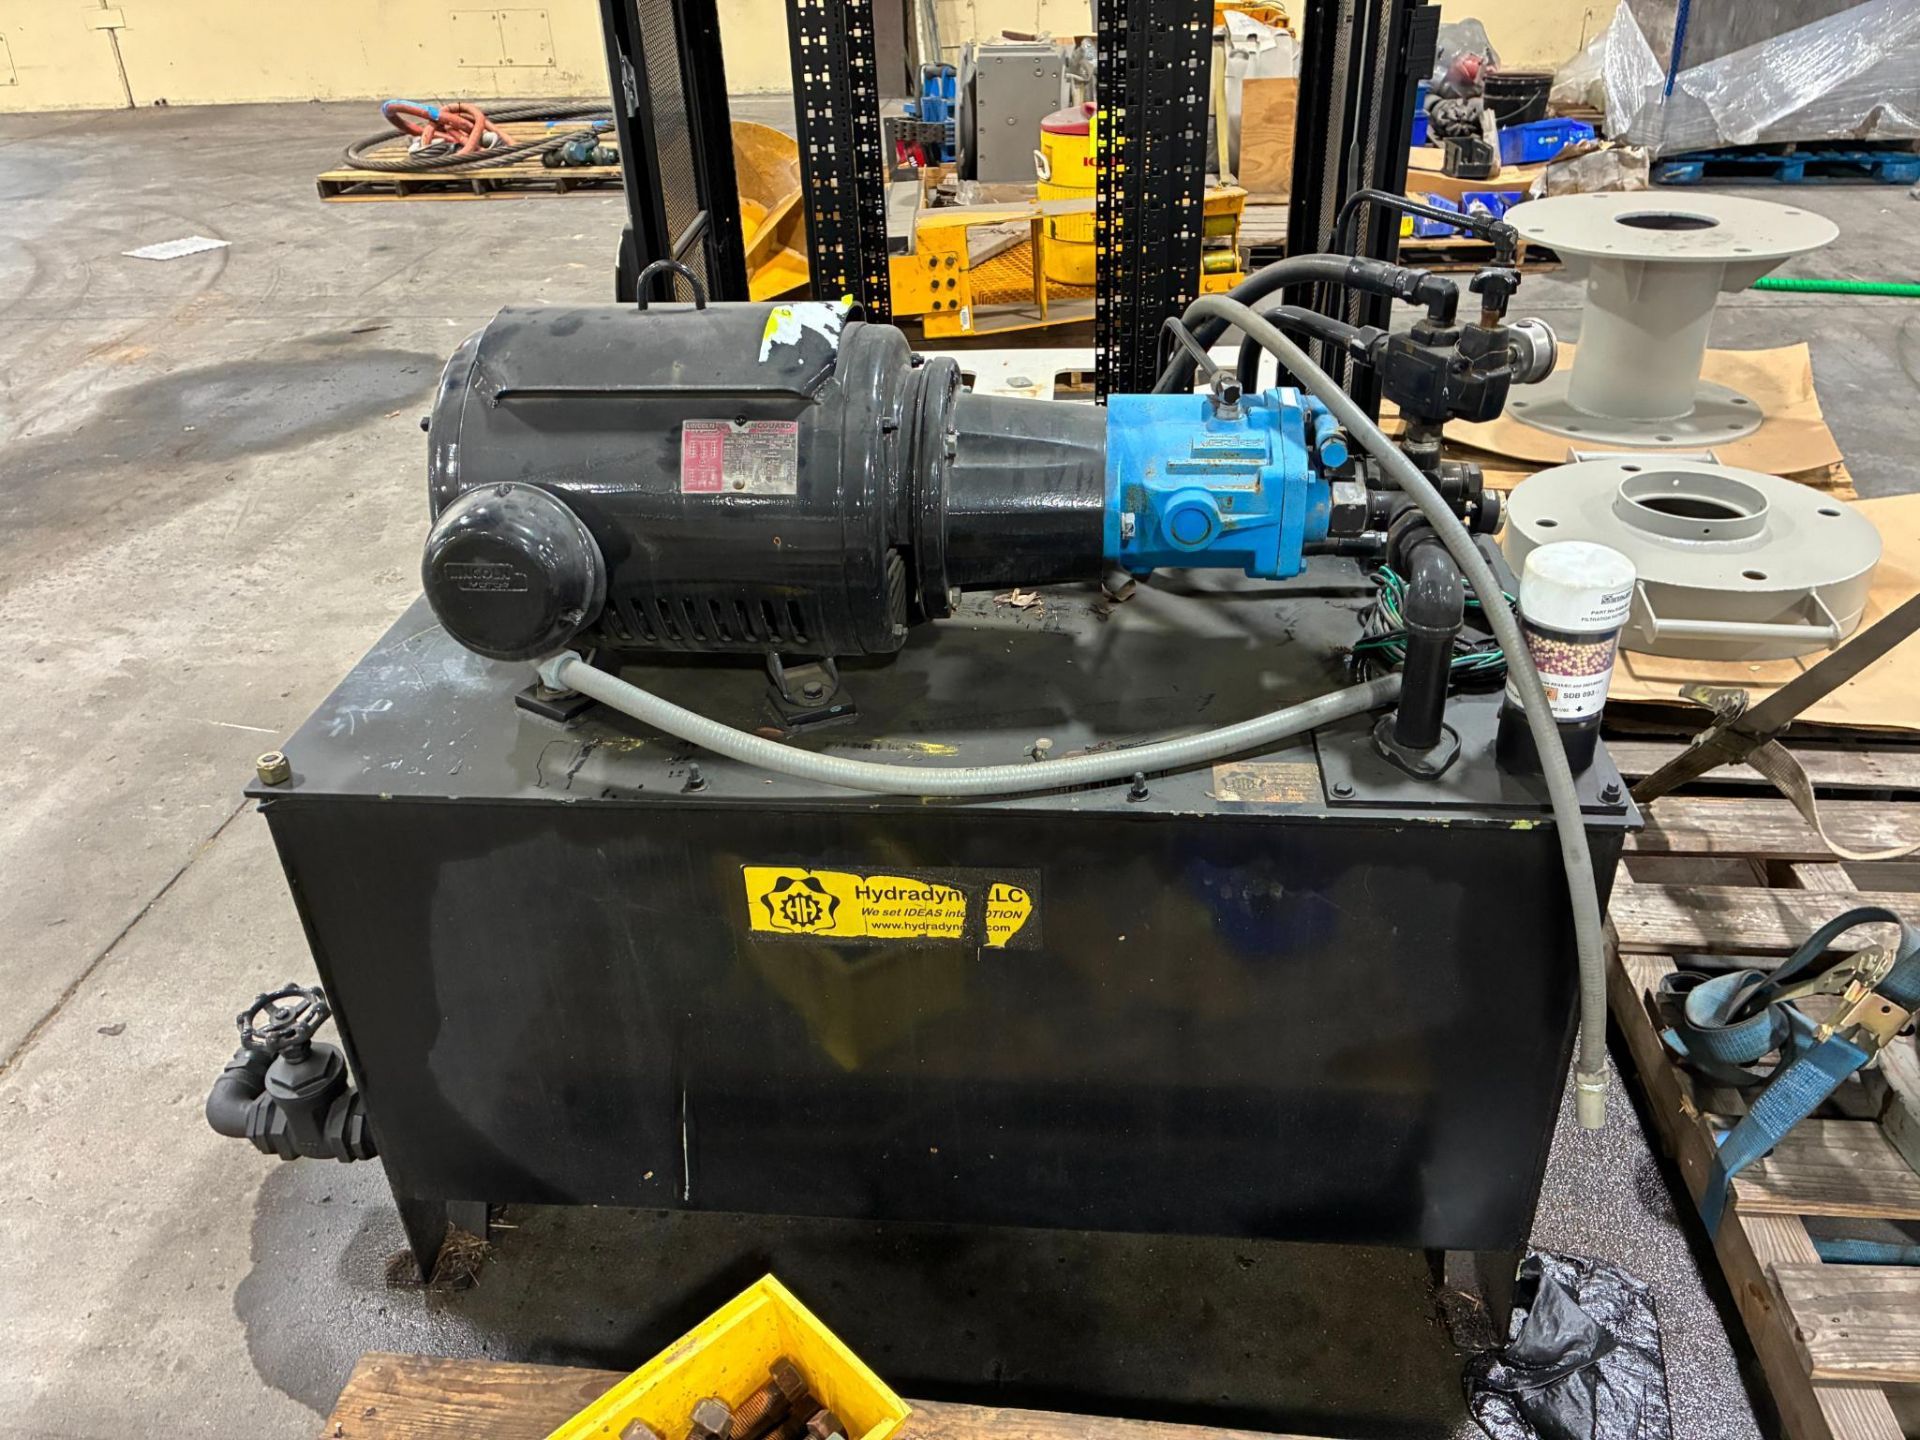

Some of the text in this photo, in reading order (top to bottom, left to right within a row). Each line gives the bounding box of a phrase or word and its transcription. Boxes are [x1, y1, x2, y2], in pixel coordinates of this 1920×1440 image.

[987, 887, 1024, 903] LC
[861, 907, 880, 916] We
[882, 908, 902, 916] set
[903, 908, 943, 918] IDEAS
[985, 909, 1023, 919] OTION
